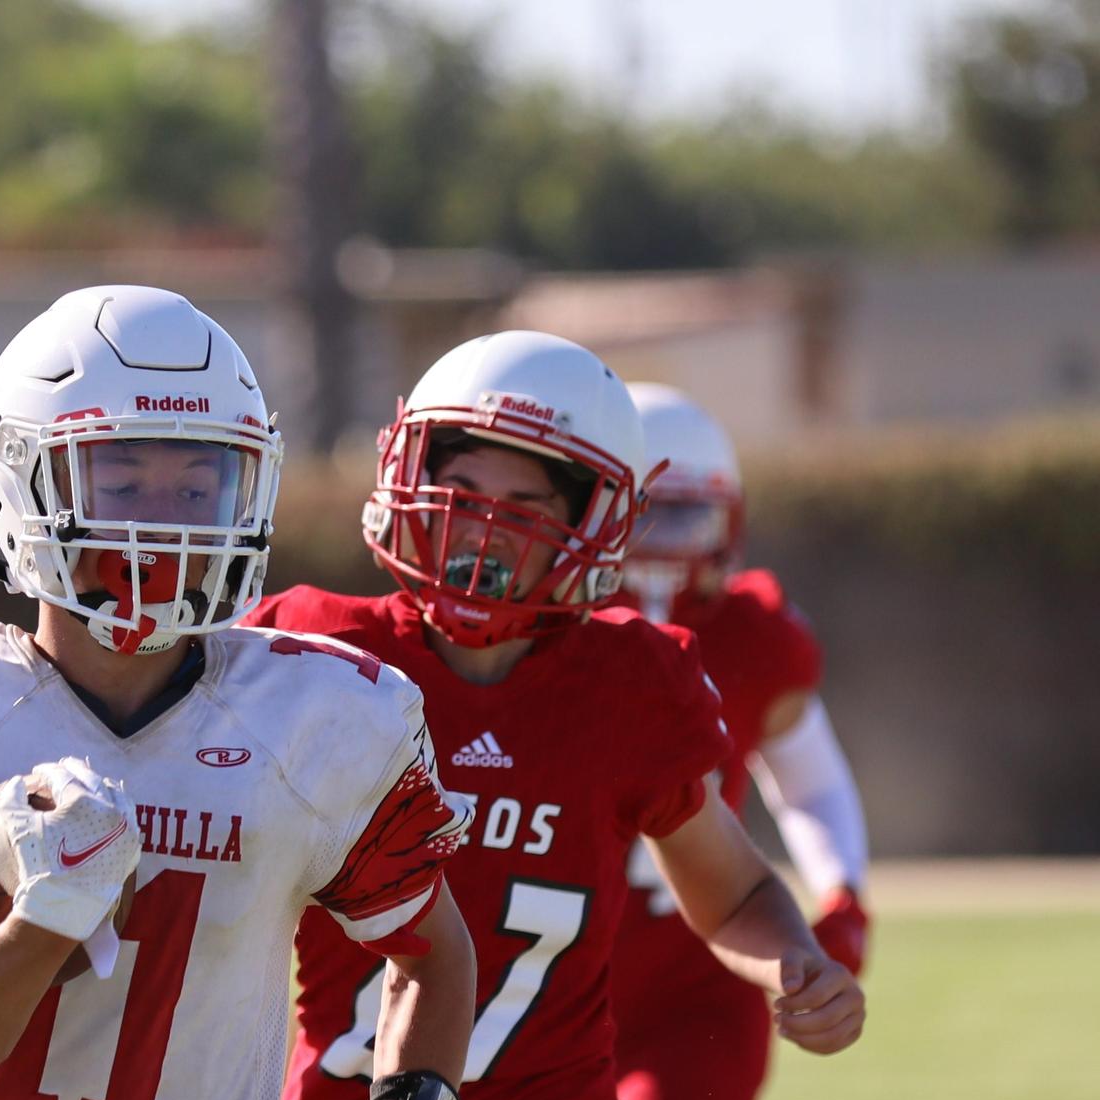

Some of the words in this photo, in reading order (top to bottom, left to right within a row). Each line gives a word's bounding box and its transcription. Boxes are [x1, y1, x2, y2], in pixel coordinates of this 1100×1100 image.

[135, 396, 210, 412] Riddell
[501, 396, 554, 422] Riddell
[138, 641, 170, 652] ddell
[451, 752, 513, 768] adidas
[136, 804, 242, 862] HILLA
